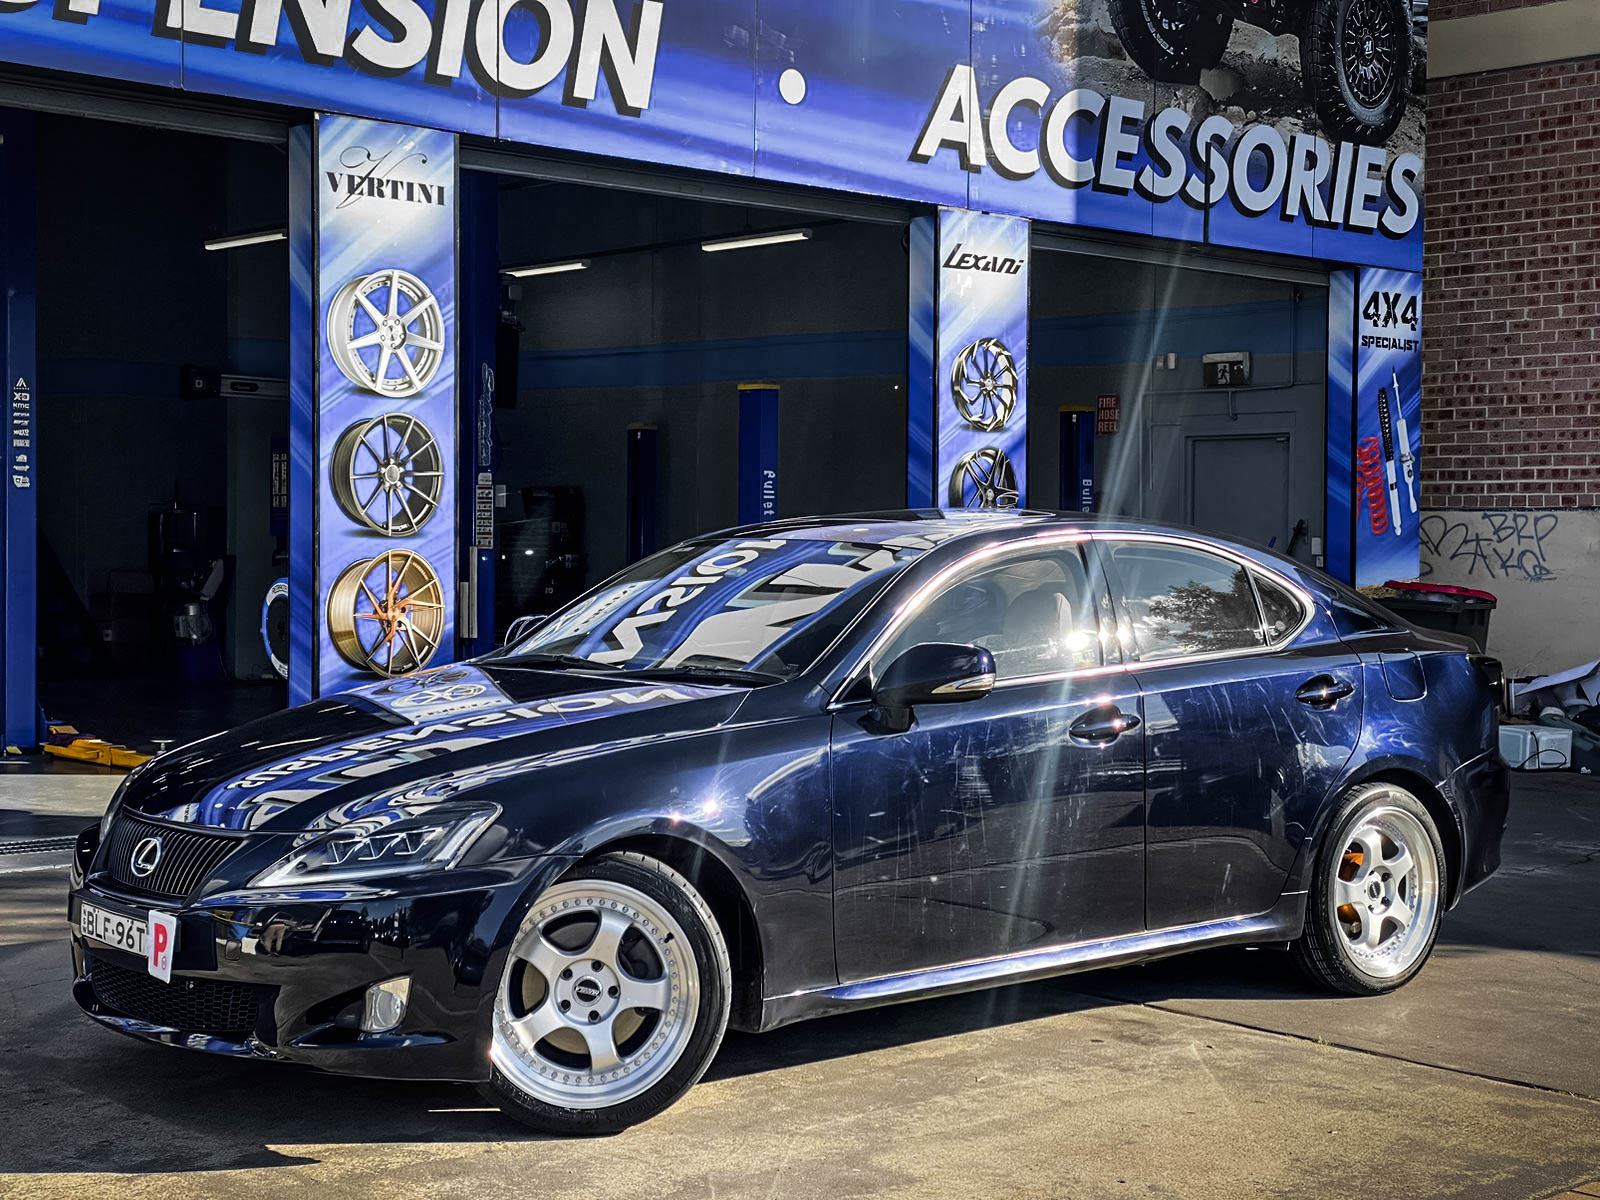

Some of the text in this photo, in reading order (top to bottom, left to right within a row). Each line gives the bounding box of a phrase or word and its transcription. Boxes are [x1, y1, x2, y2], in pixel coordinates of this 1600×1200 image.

[914, 64, 1421, 235] ACCESSORIES
[326, 171, 446, 206] VERTINI
[1363, 291, 1418, 331] 4X4
[1361, 335, 1419, 352] SPECIALIST
[1098, 398, 1117, 408] FIRE
[1098, 409, 1120, 420] HOSE
[1097, 420, 1118, 432] REEL
[1082, 479, 1093, 513] Bulle
[153, 923, 168, 967] P
